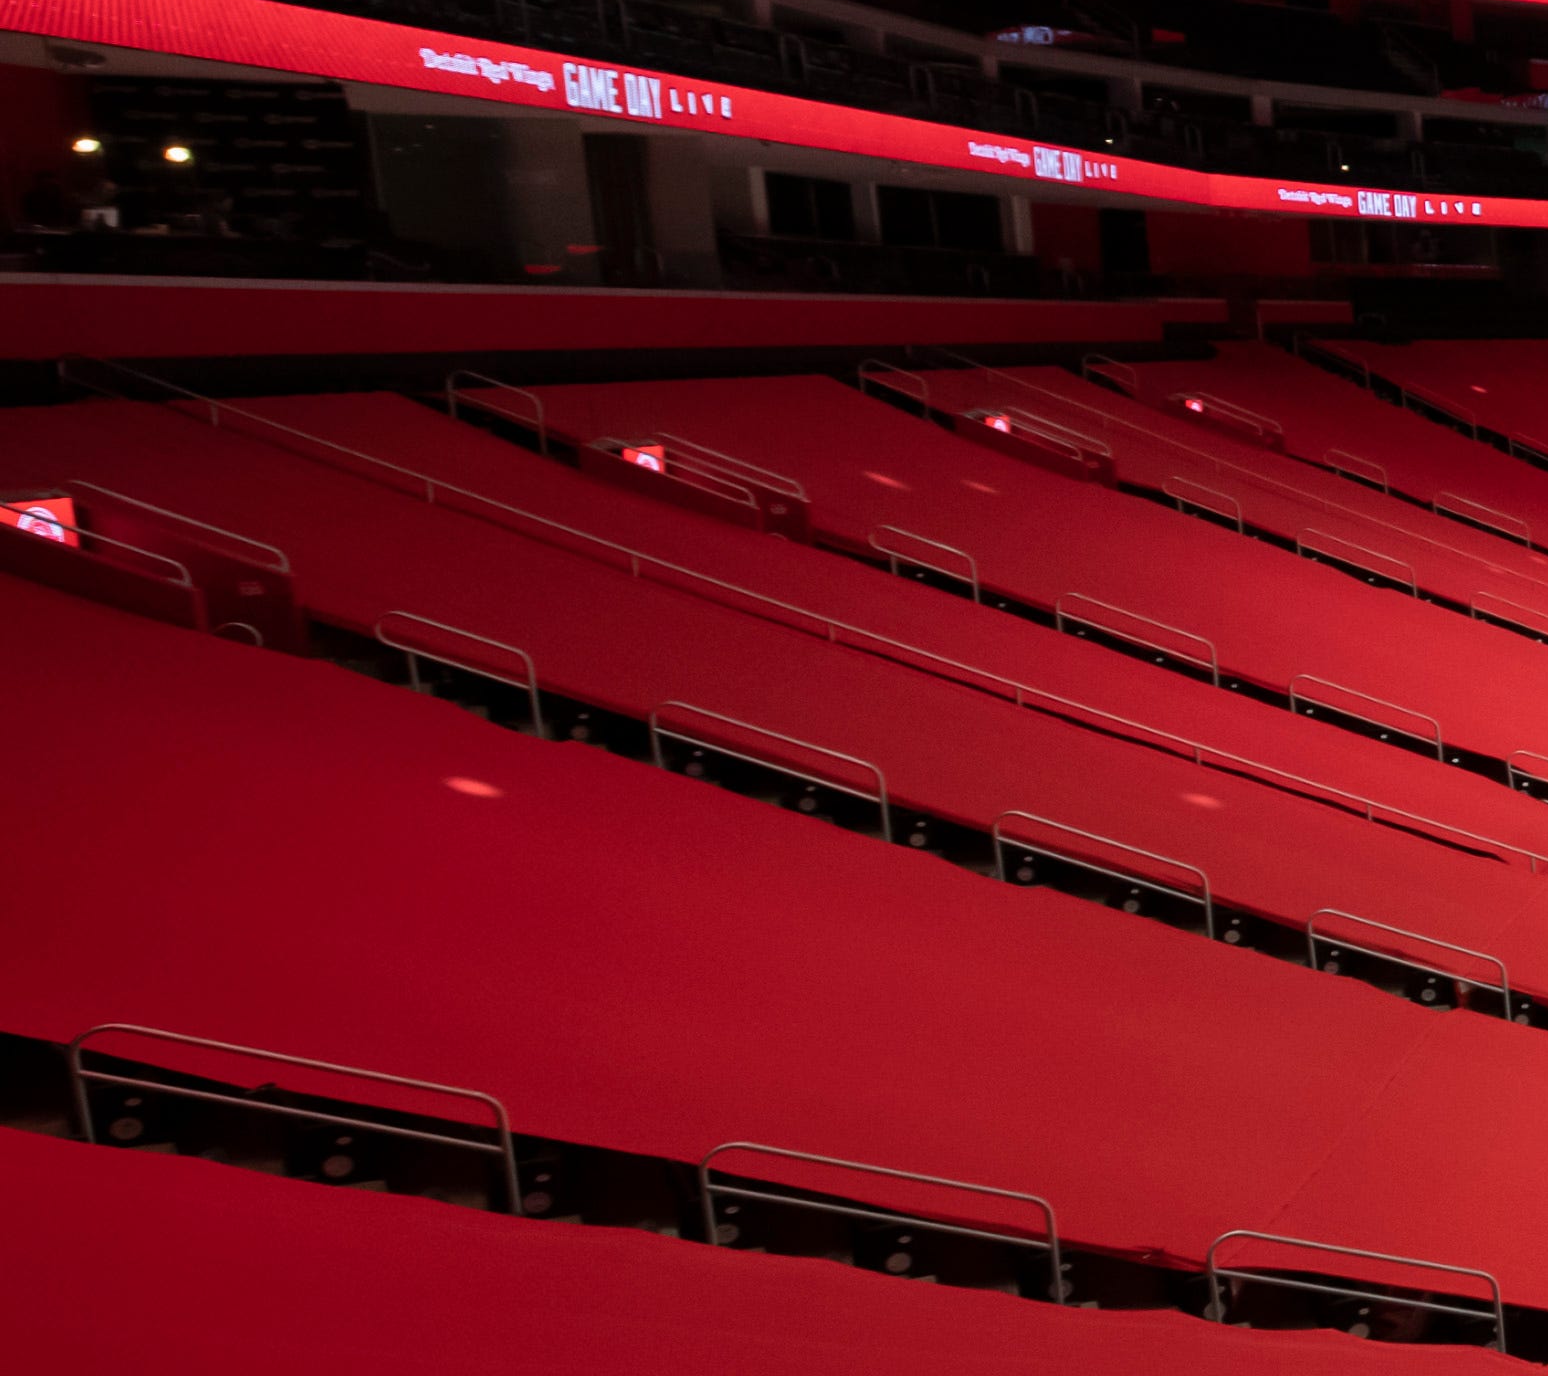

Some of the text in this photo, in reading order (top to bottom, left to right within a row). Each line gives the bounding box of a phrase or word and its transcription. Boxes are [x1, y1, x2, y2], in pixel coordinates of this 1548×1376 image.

[562, 62, 623, 114] GAME
[624, 72, 662, 119] DAY
[669, 88, 732, 119] LIVE
[1357, 190, 1392, 216] GAME
[1394, 194, 1416, 218] DAY
